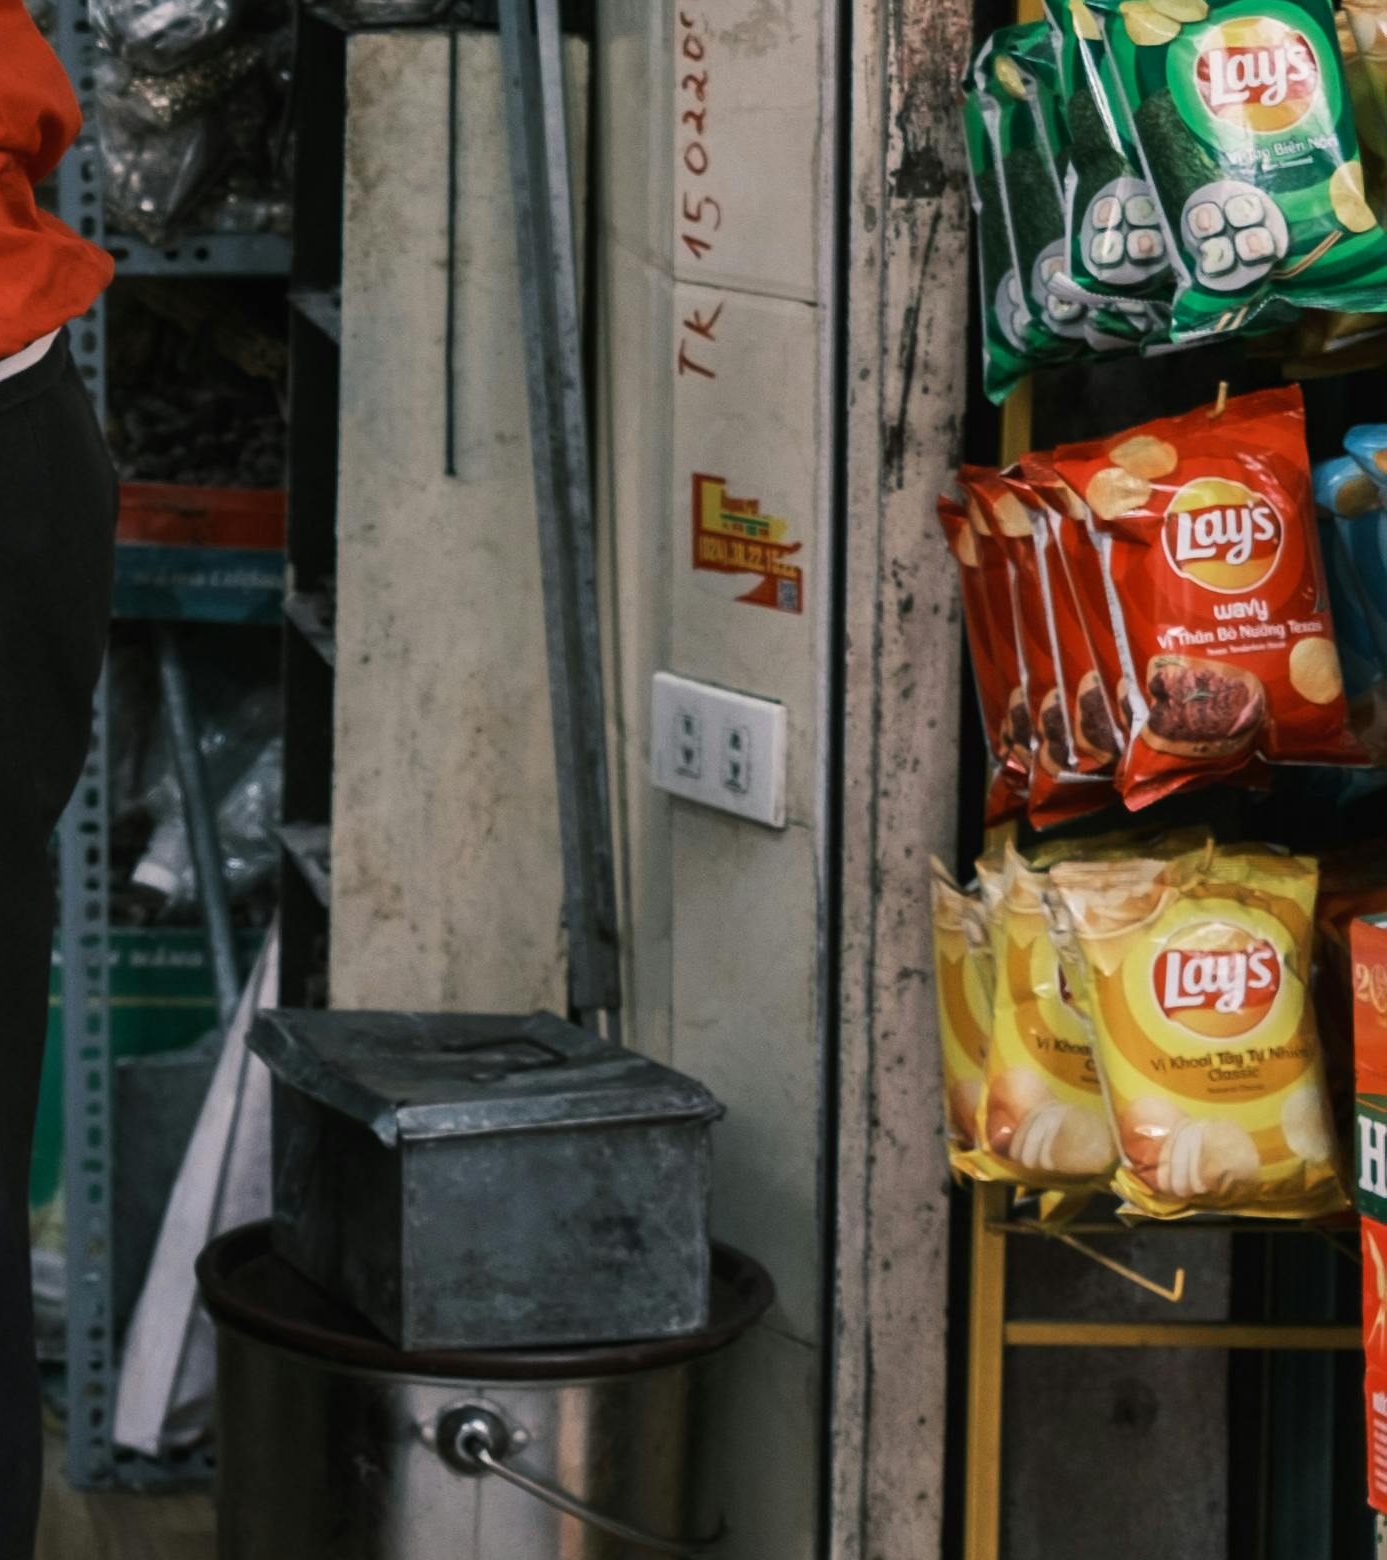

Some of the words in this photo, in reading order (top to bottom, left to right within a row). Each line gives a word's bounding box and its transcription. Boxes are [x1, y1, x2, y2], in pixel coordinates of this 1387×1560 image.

[1175, 499, 1276, 565] Lay's
[1213, 597, 1269, 622] wavy
[1164, 942, 1273, 1013] Lay's
